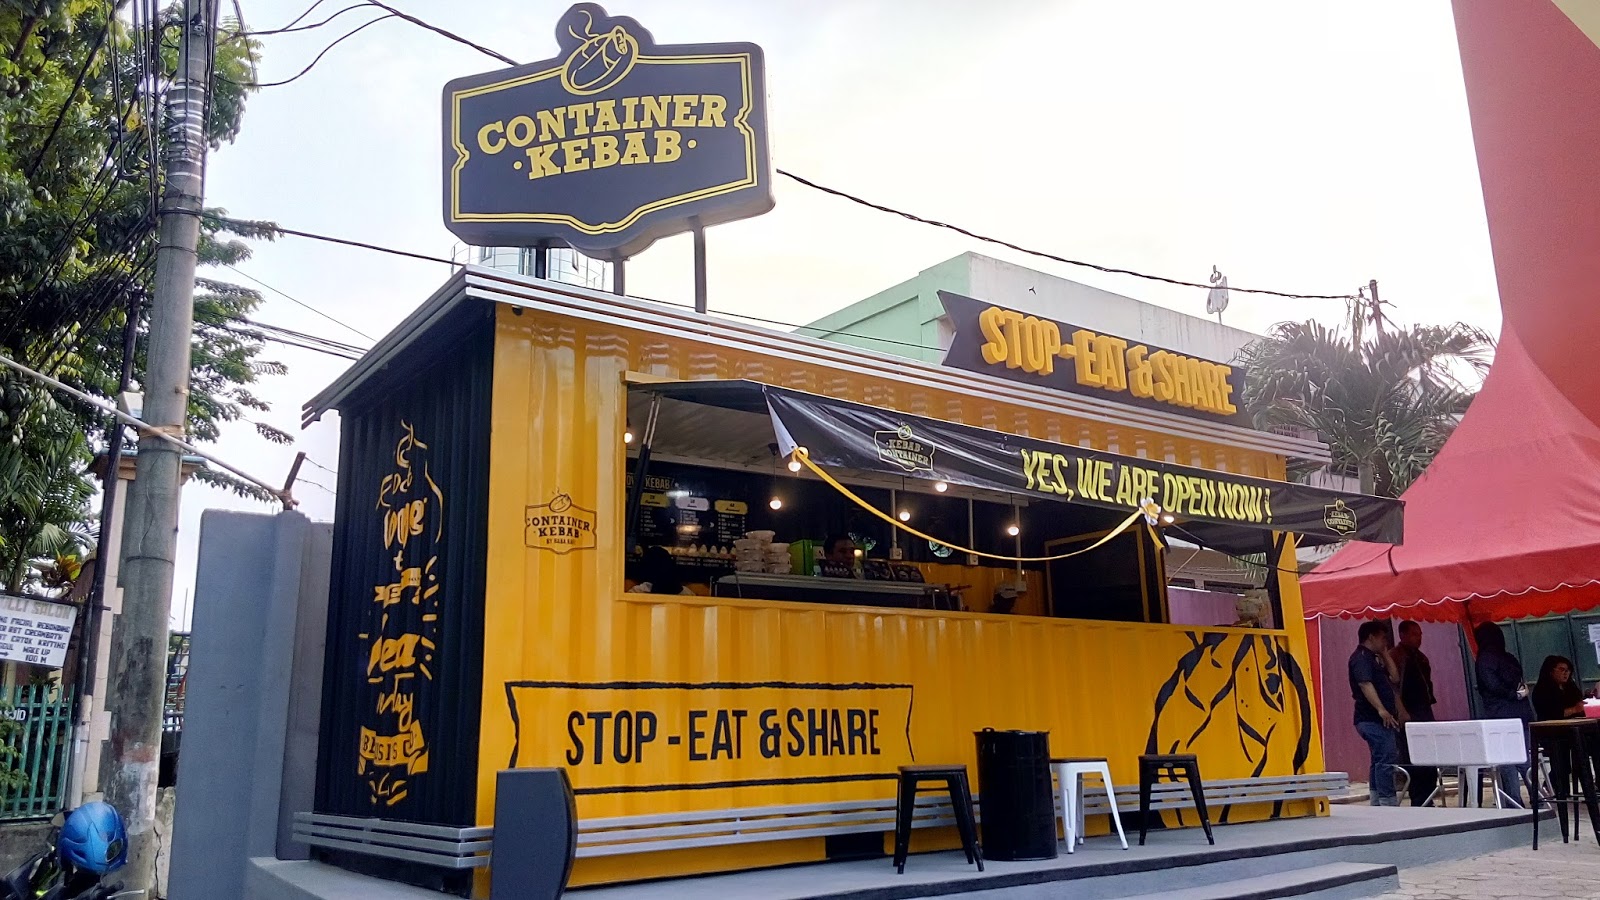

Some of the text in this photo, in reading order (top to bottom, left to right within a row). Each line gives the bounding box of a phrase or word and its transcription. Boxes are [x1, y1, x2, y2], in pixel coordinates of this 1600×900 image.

[476, 94, 728, 154] CONTAINER
[888, 439, 921, 452] KEBAB
[1020, 449, 1075, 501] YES,
[1077, 457, 1114, 502] WE
[1116, 465, 1161, 507] ARE
[1162, 473, 1217, 517] OPEN
[538, 526, 580, 538] KEBAB
[31, 601, 72, 619] SALON
[37, 621, 71, 633] REBONDING
[24, 629, 63, 640] CREAMBATH
[23, 646, 39, 654] MAKE
[566, 710, 658, 766] STOP
[689, 710, 747, 761] EAT
